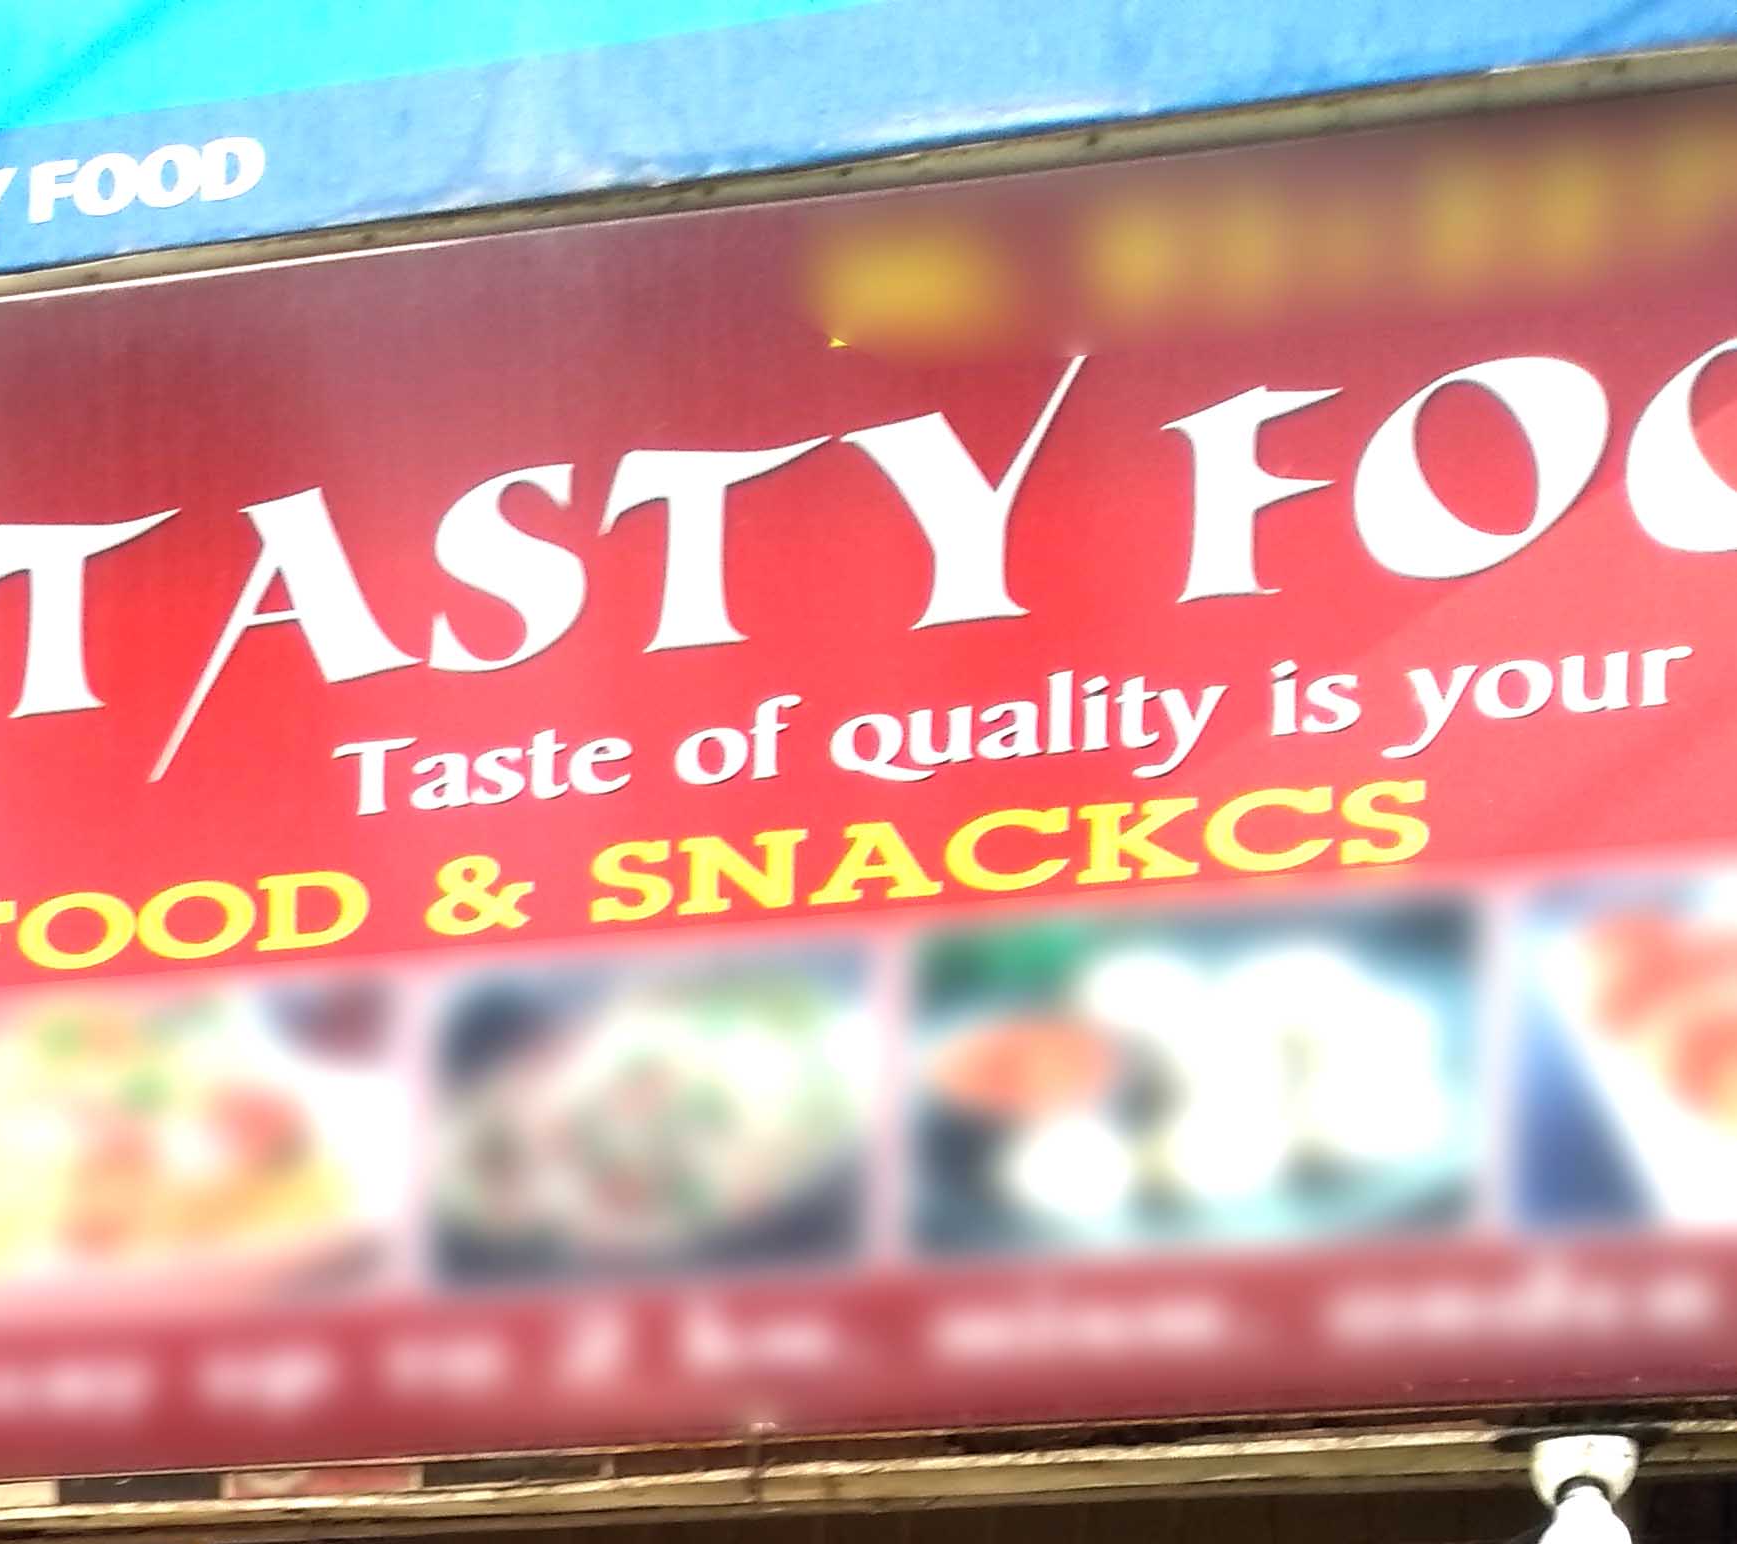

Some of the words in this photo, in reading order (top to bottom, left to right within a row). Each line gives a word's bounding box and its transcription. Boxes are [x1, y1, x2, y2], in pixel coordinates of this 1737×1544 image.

[27, 136, 266, 224] FOOD
[332, 730, 633, 816] Taste
[674, 694, 802, 785] of
[828, 670, 1229, 782] quality
[1269, 659, 1362, 737] is
[1381, 645, 1694, 759] your
[424, 853, 533, 936] &
[589, 778, 1431, 923] SNACKCS
